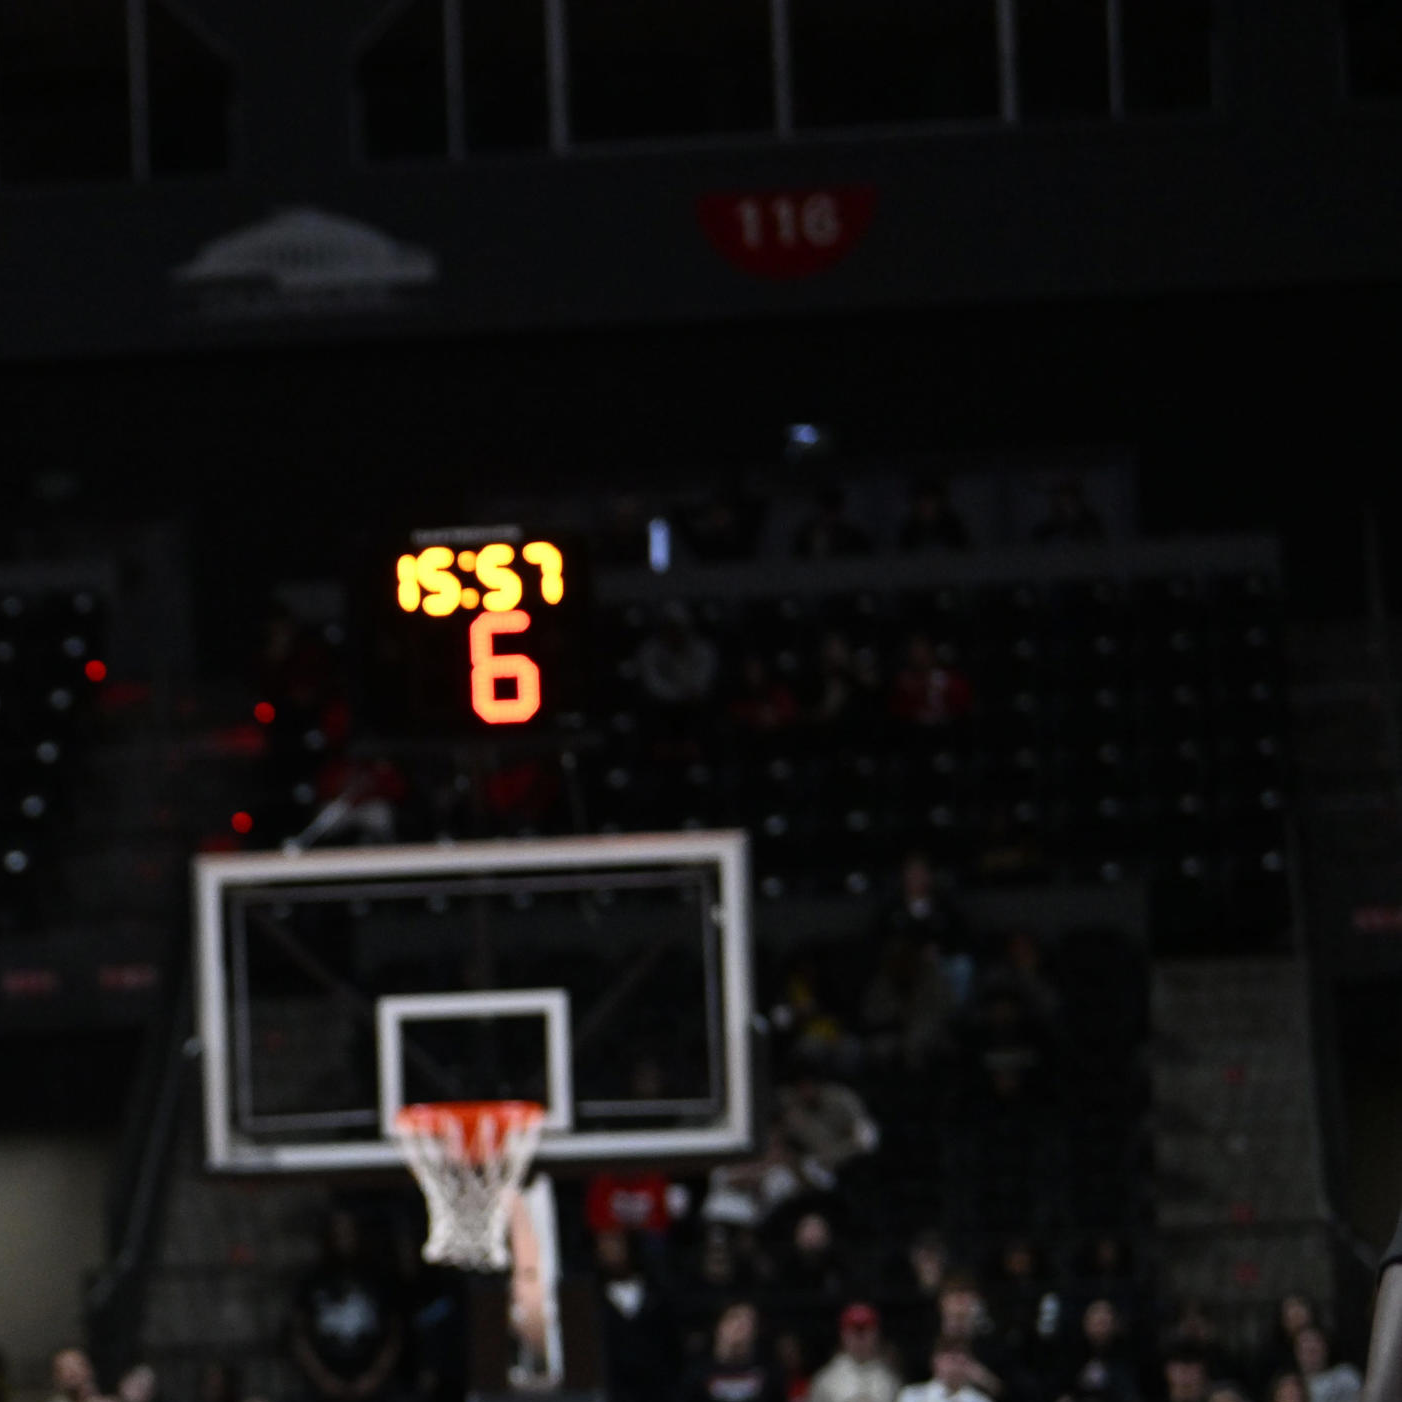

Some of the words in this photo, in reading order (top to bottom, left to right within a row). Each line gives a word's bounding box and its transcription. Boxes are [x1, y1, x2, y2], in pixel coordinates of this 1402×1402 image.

[736, 192, 844, 250] 116
[396, 540, 564, 617] 15:57
[469, 609, 541, 724] 6
